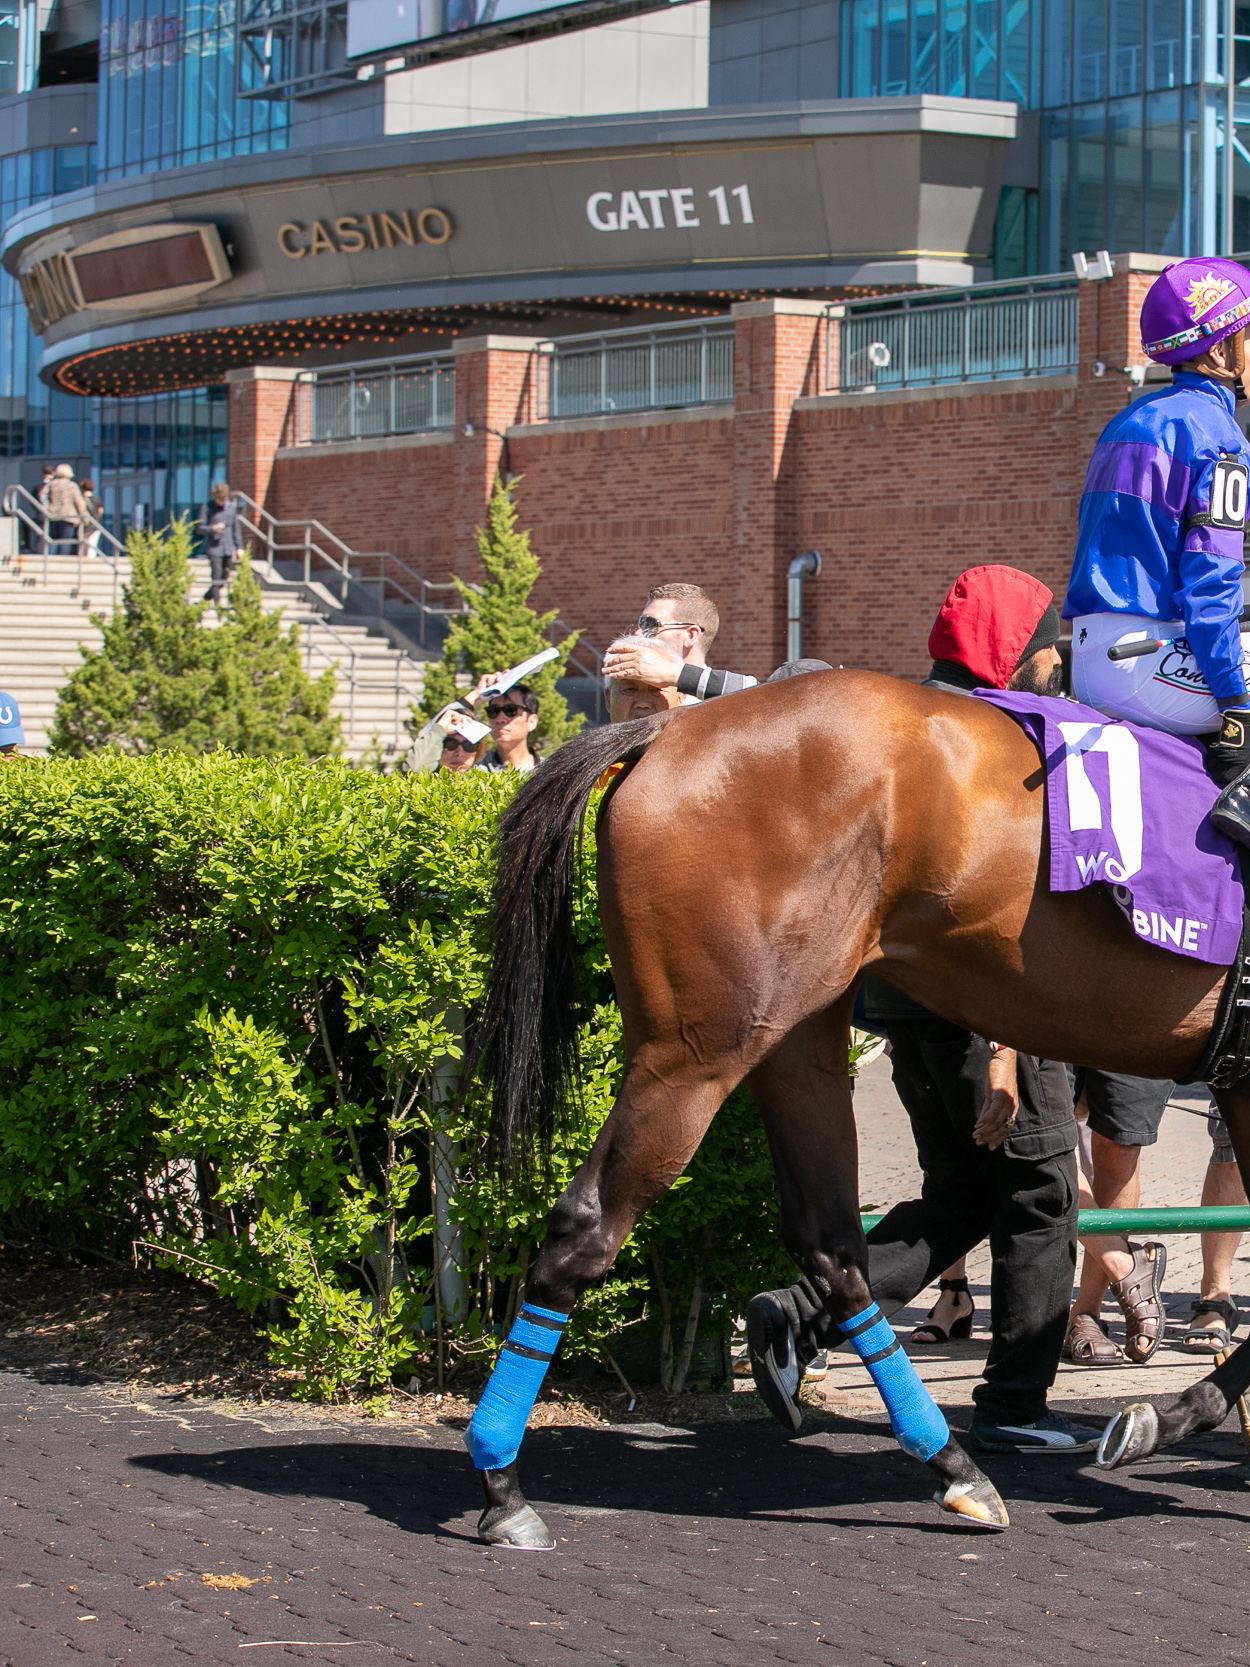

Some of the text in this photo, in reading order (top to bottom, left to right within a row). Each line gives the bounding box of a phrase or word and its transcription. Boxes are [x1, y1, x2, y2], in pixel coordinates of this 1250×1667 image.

[277, 208, 452, 259] CASINO
[587, 185, 754, 232] GATE 11
[1213, 466, 1248, 524] 10
